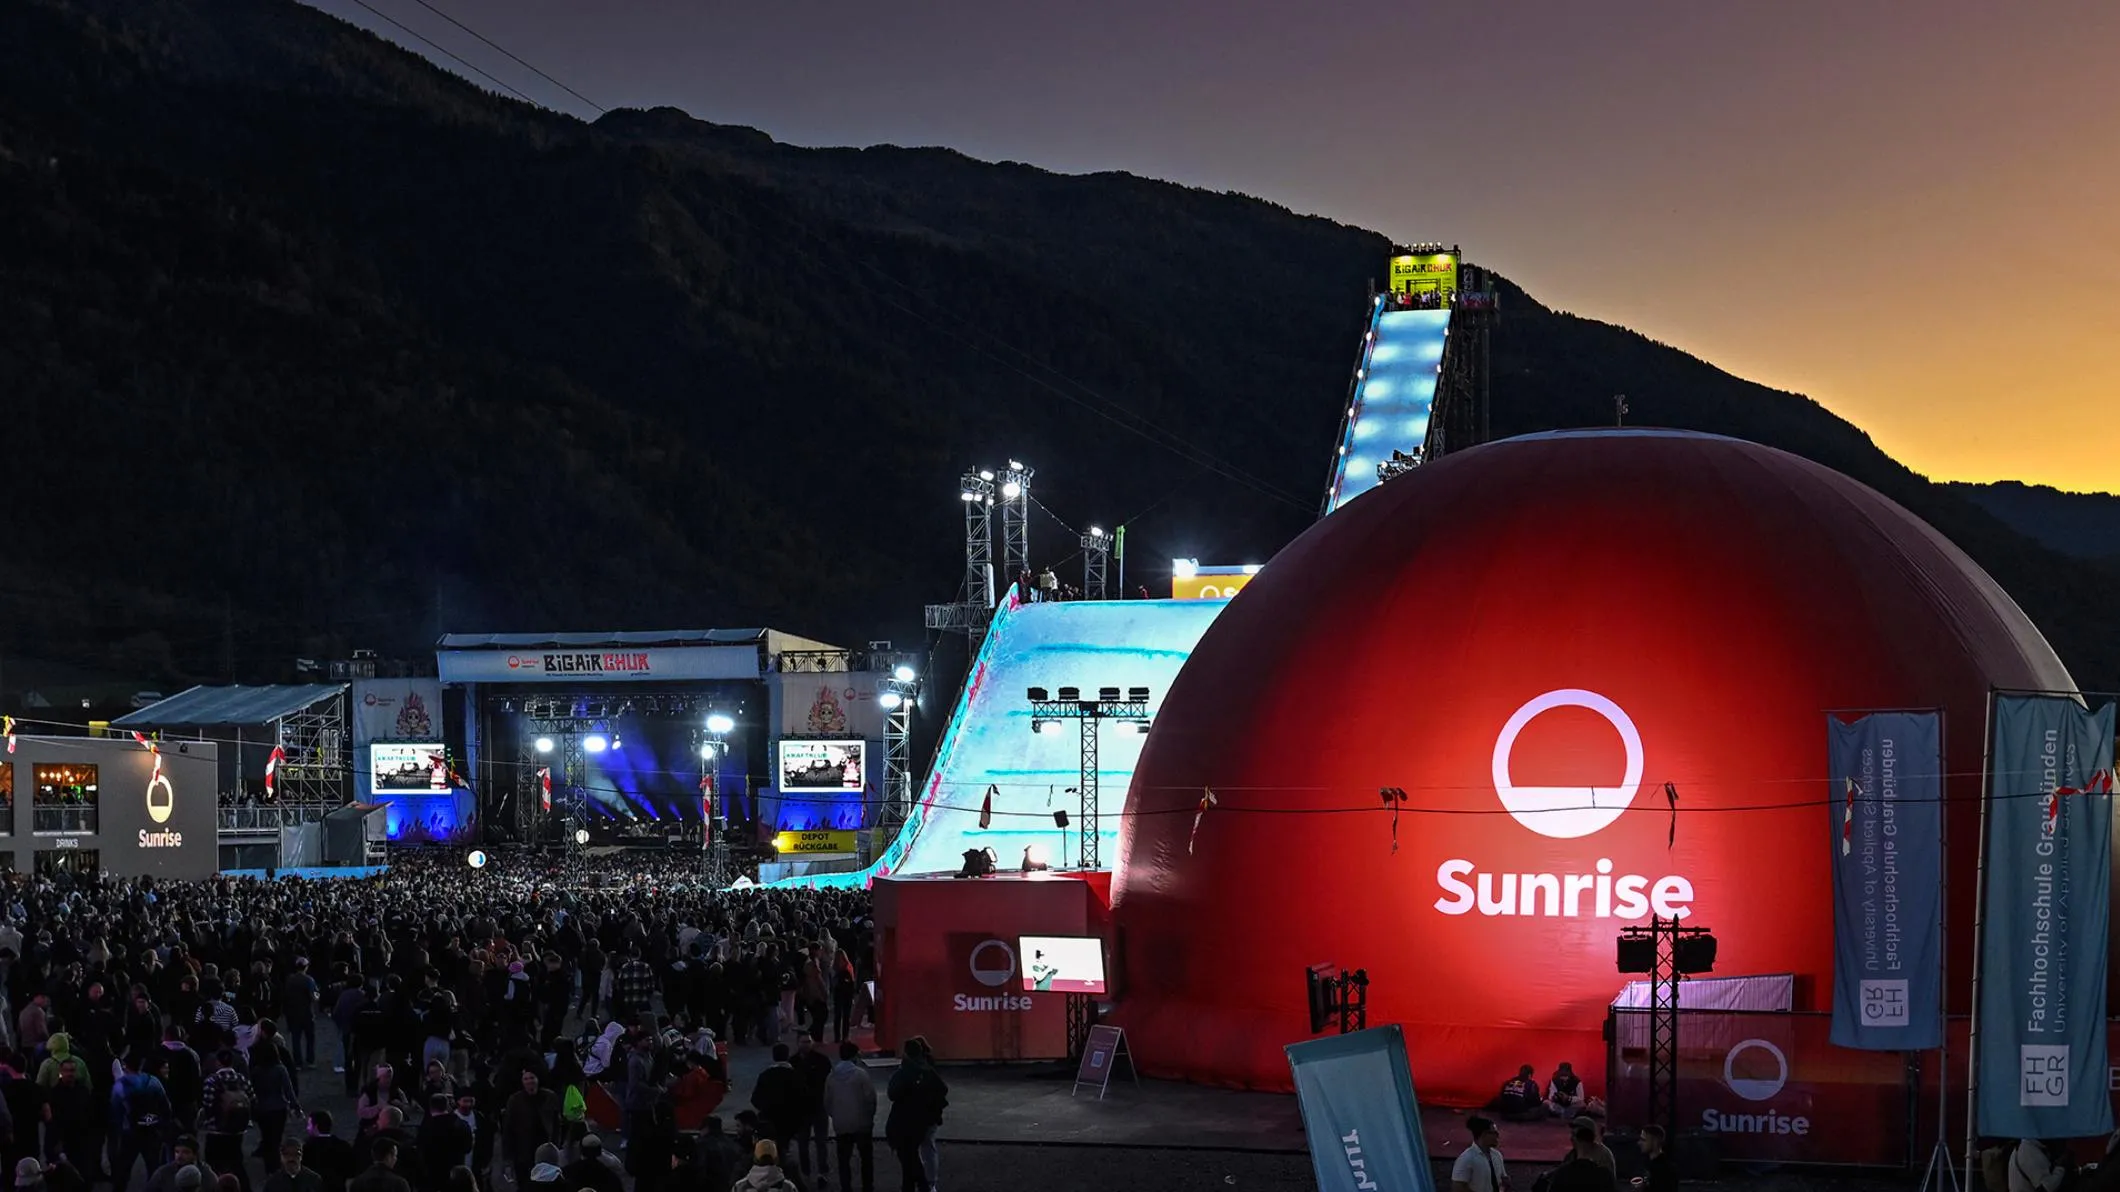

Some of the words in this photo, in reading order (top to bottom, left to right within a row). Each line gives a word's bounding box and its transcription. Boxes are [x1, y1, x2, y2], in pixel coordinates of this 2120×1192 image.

[56, 838, 79, 849] DRINKS
[139, 828, 182, 848] Sunrise
[793, 841, 838, 850] RÜCKGABE
[801, 833, 829, 841] DEPOT
[1433, 858, 1694, 919] Sunrise
[2057, 913, 2067, 933] of
[2028, 864, 2053, 1032] Fachhochschule
[2054, 939, 2067, 1032] University
[953, 992, 1033, 1011] Sunrise
[2026, 1056, 2045, 1094] FH
[2046, 1055, 2065, 1096] GR
[1702, 1107, 1810, 1136] Sunrise
